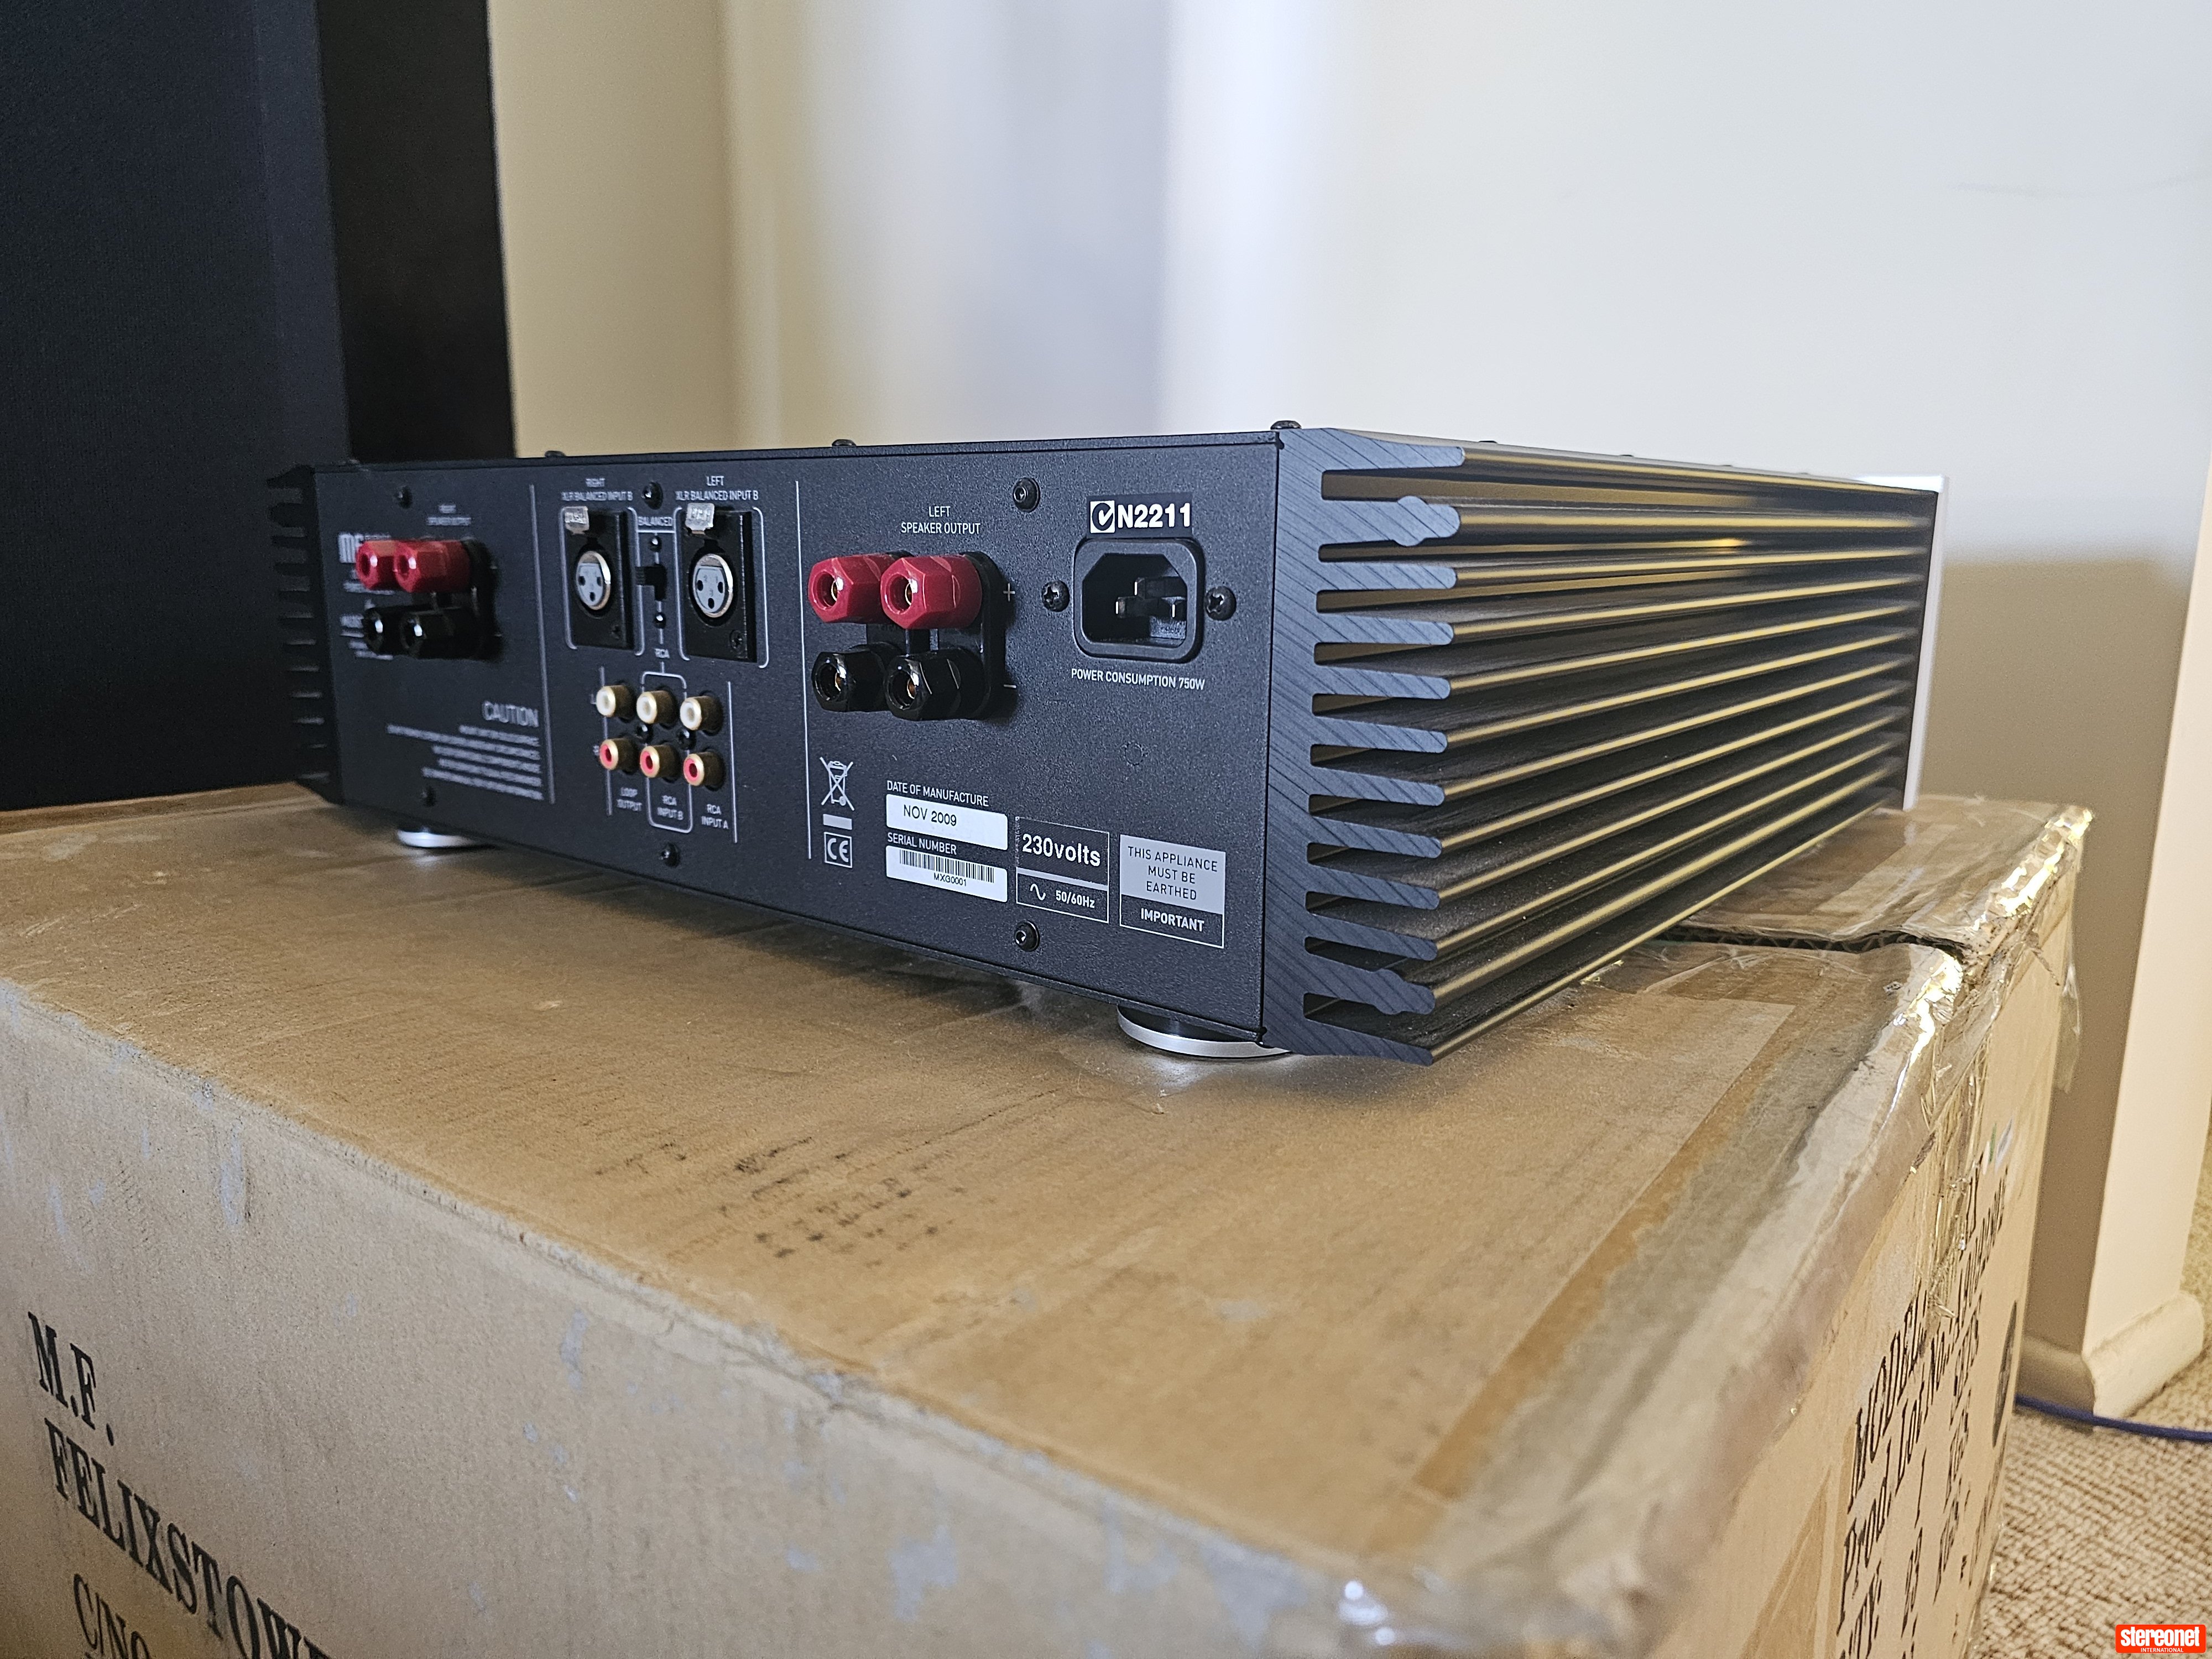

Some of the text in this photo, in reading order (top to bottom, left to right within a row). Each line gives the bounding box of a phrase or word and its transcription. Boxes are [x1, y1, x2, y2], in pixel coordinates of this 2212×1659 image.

[706, 476, 724, 486] LEFT
[627, 491, 633, 501] B
[675, 491, 759, 500] XLR BALANCED INPUT B
[638, 517, 673, 526] BALANCED
[928, 506, 951, 518] LEFT
[1118, 503, 1191, 528] N2211
[901, 523, 981, 535] SPEAKER OUTPUT
[655, 648, 670, 658] RCA
[1071, 668, 1206, 691] POWER CONSUMPTION 750W
[662, 795, 677, 806] RCA
[887, 780, 989, 807] DATE OF MANUFACTURE
[617, 799, 642, 811] OUTPUT
[657, 807, 684, 821] INPUT B
[707, 804, 722, 815] RCA
[701, 816, 729, 830] INPUT A
[904, 804, 957, 826] NOV 2009
[827, 838, 849, 863] CE
[888, 832, 957, 855] SERIAL NUMBER
[1022, 833, 1100, 867] 230volts
[1128, 846, 1218, 872] THIS APPLIANCE
[1148, 867, 1196, 884] MUST BE
[1056, 890, 1095, 909] 50/60Hz
[1146, 881, 1197, 900] EARTHED
[1141, 907, 1205, 932] IMPORTANT
[28, 1311, 114, 1446] M.F.
[1837, 1436, 1892, 1637] Prod.
[1895, 1363, 1925, 1496] Lot
[44, 1417, 333, 1659] FELIXSTOW
